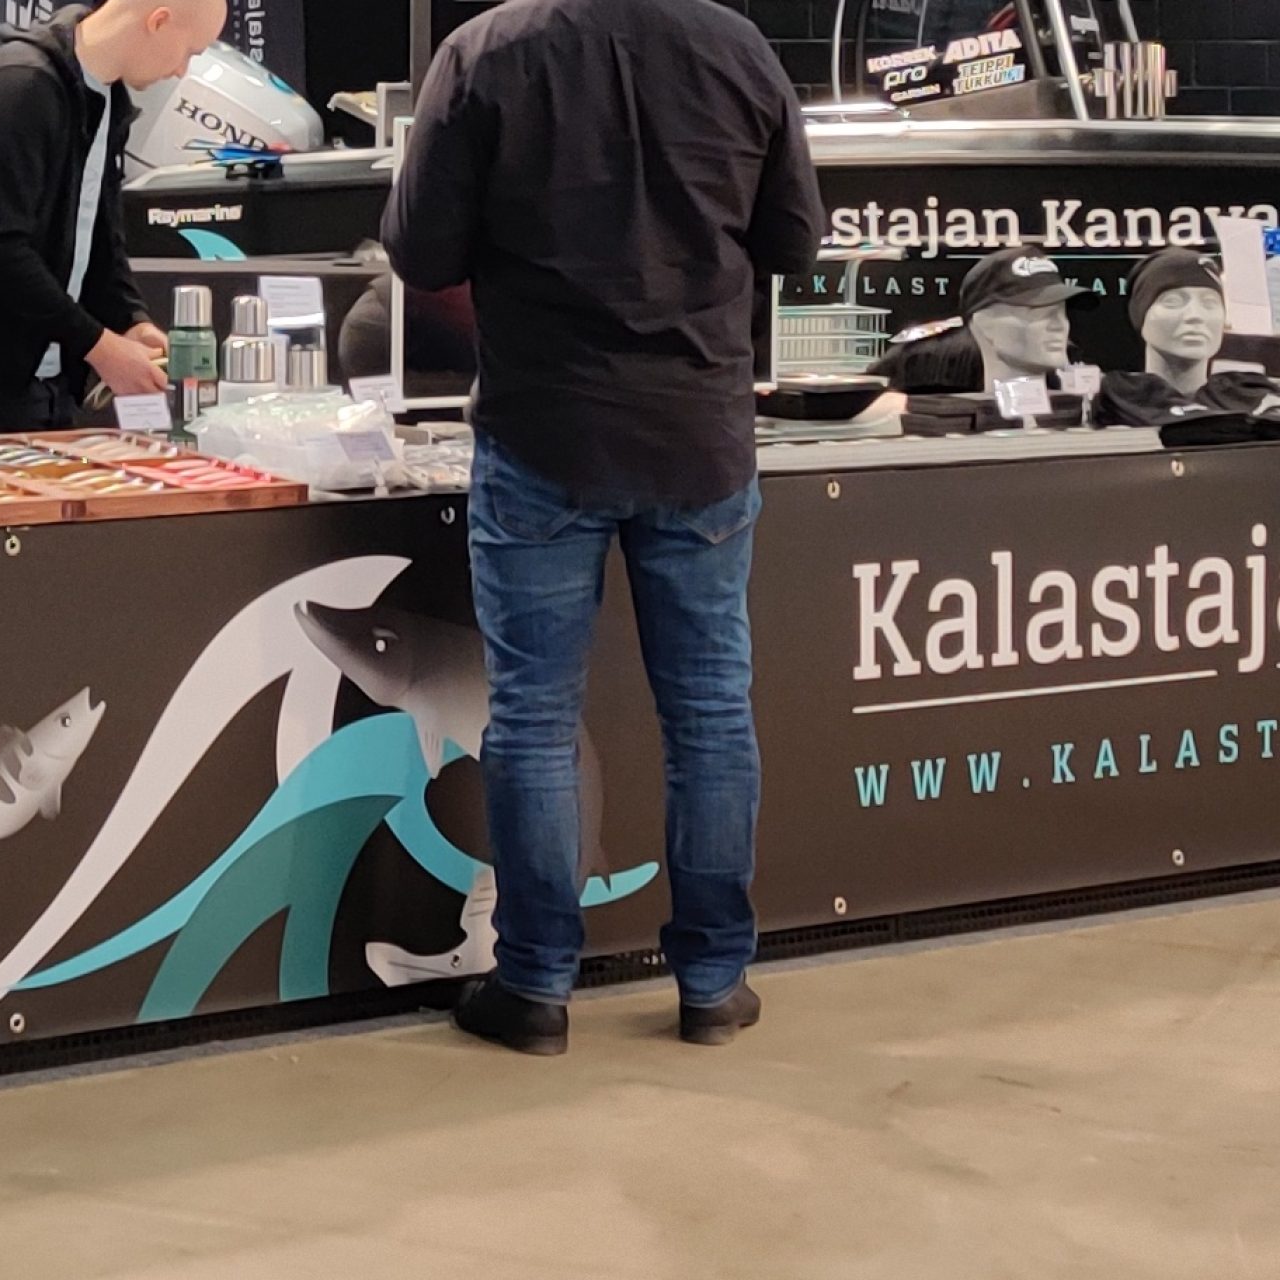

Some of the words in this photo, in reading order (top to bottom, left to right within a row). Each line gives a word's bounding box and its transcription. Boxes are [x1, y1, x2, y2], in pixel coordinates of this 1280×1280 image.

[174, 97, 269, 152] HOND
[147, 204, 243, 227] Raymarine
[821, 196, 1021, 259] stajan
[852, 523, 1280, 681] Kalastaj
